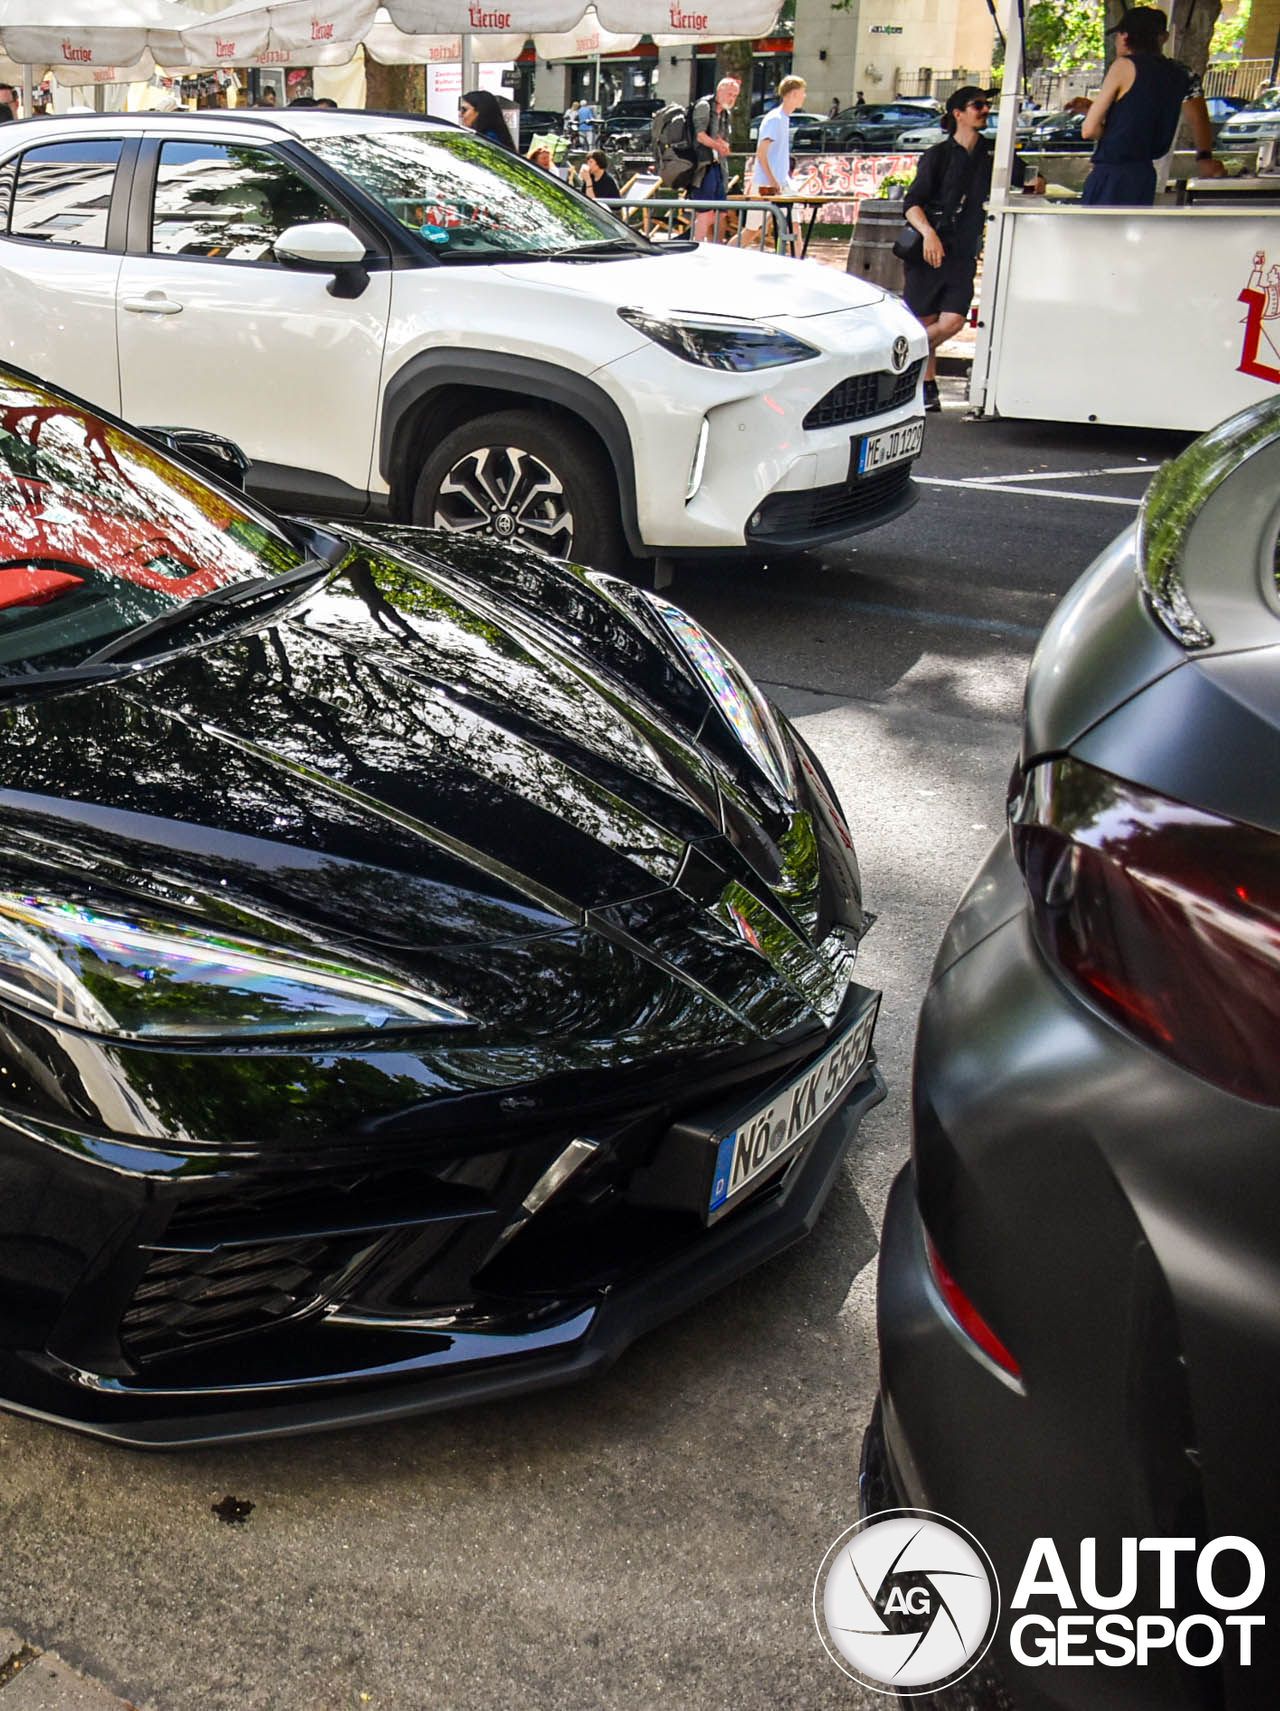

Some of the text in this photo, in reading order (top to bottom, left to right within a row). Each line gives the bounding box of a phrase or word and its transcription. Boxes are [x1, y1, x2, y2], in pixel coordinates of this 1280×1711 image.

[469, 7, 511, 29] Uerige
[670, 9, 708, 30] Uerige
[731, 1109, 774, 1186] NÖ
[787, 1063, 824, 1140] KK
